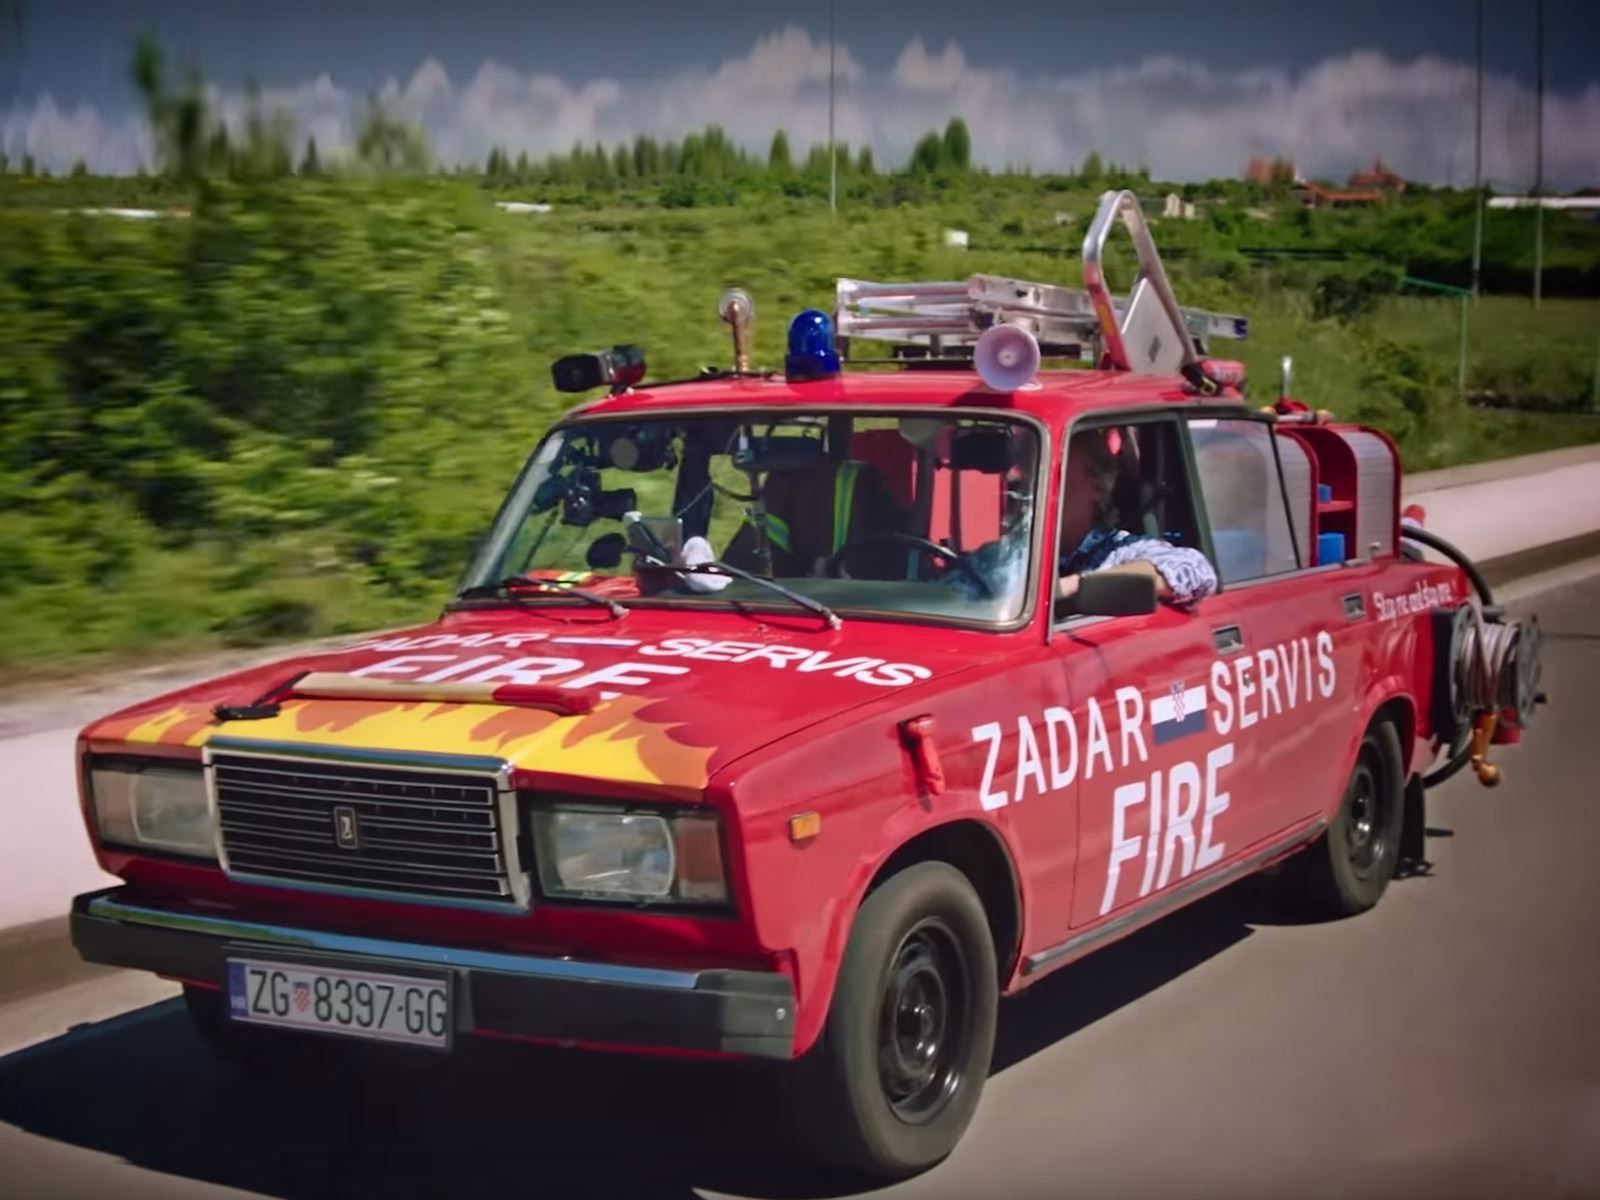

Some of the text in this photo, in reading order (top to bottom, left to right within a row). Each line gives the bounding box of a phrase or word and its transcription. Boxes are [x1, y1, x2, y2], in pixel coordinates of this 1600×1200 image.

[350, 655, 691, 700] FIRE
[638, 638, 933, 687] SERVIS
[972, 631, 1336, 811] ZADAR SERVIS
[1100, 743, 1234, 915] FIRE
[249, 970, 290, 1017] ZG
